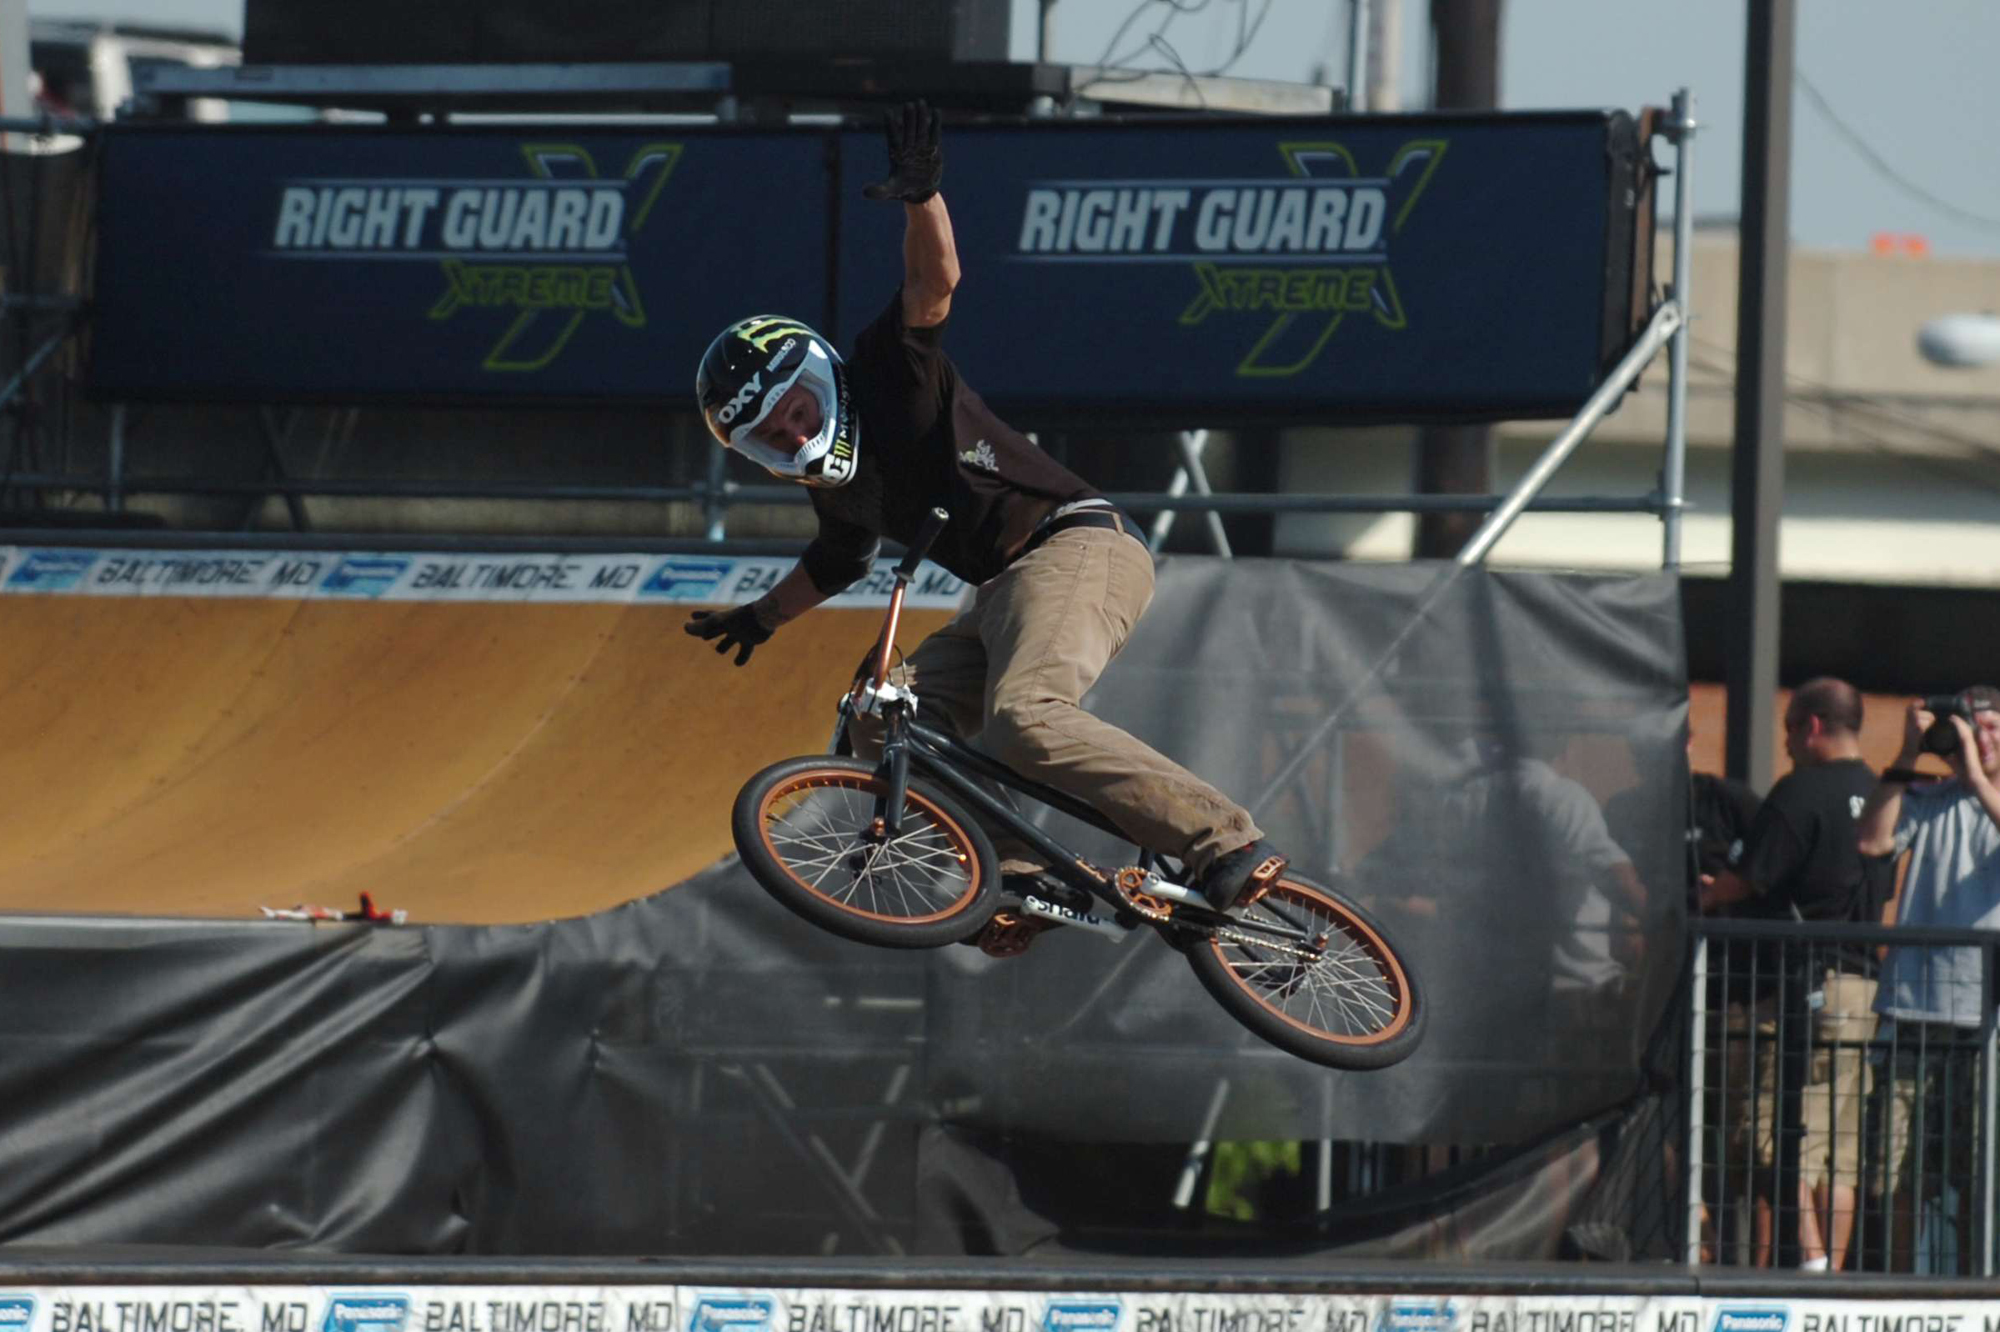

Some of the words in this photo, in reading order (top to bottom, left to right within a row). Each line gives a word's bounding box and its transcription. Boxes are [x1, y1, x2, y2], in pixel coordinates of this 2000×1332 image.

[274, 187, 440, 247] RIGHT
[442, 188, 625, 249] GUARD
[1019, 189, 1190, 251] RIGHT
[1195, 188, 1387, 251] GUARD
[428, 259, 618, 318] XTREME
[1180, 262, 1377, 323] XTREME
[718, 371, 762, 424] OXY
[271, 561, 321, 586] MD
[589, 564, 639, 590] MD
[262, 1302, 308, 1332] MD
[627, 1302, 672, 1332] MD
[981, 1306, 1024, 1332] MD
[1722, 1313, 1783, 1330] Panasonic
